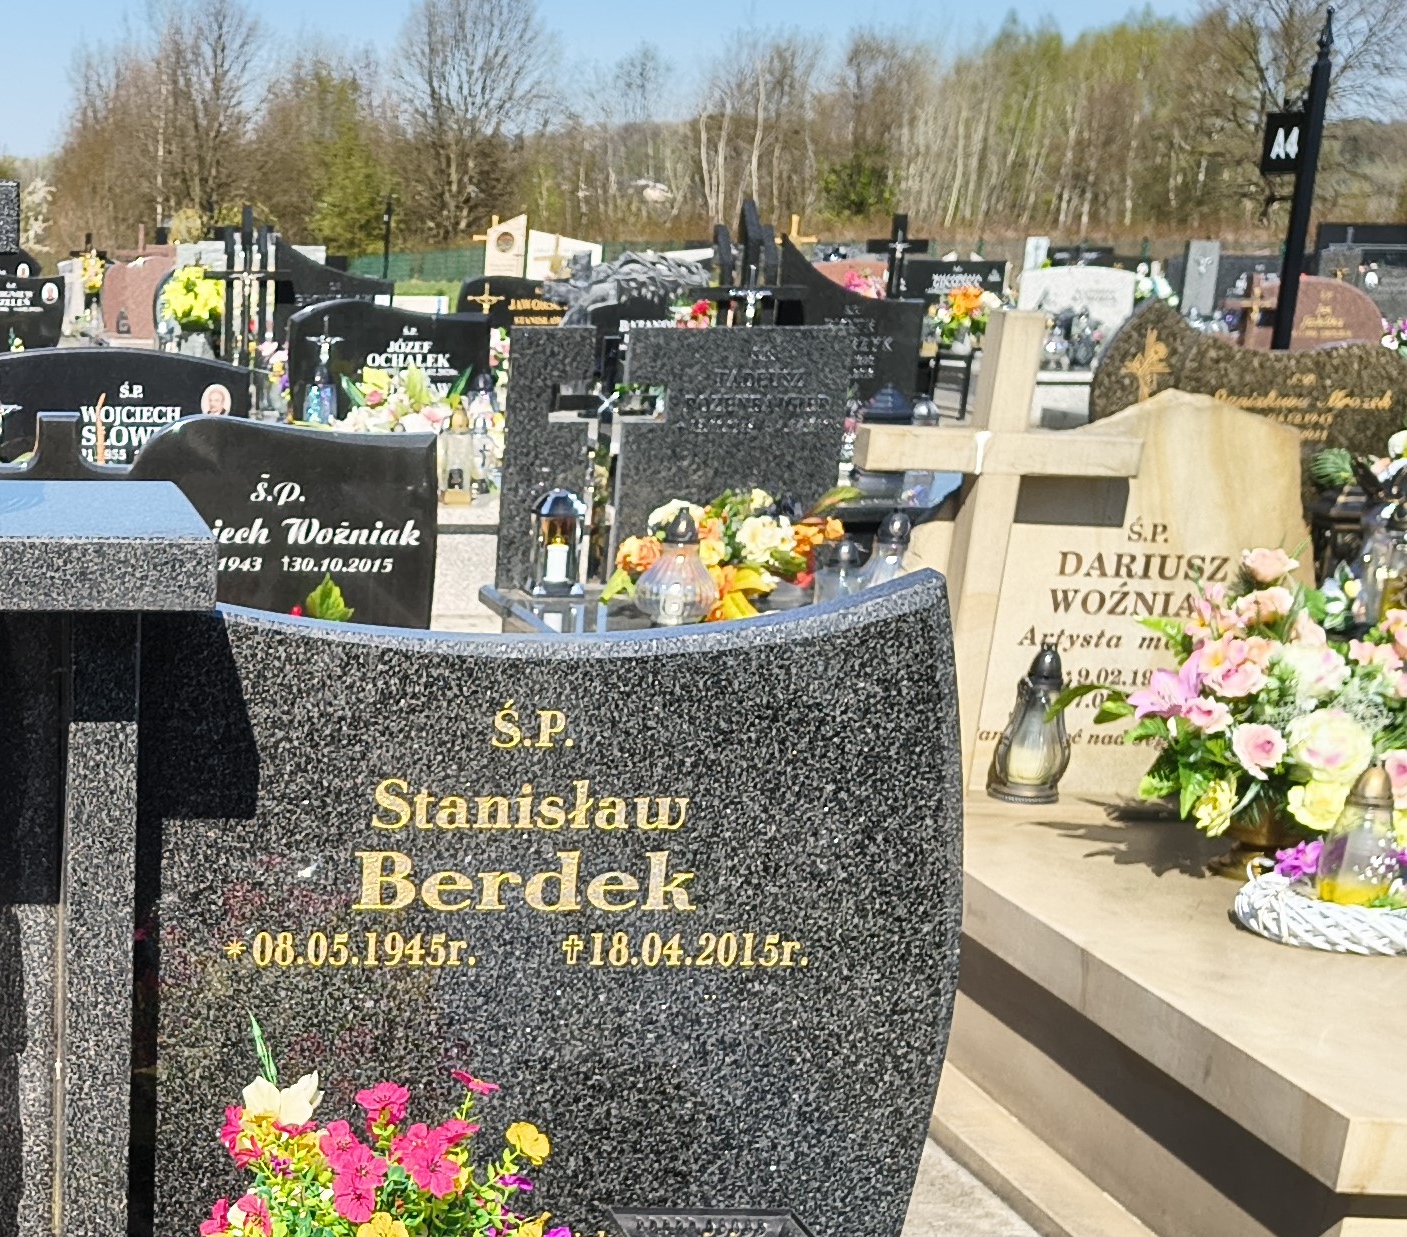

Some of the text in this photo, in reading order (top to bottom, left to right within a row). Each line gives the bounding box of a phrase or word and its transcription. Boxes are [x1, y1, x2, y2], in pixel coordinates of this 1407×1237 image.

[386, 337, 433, 353] JÓZEF
[80, 405, 182, 427] WOJCIECH
[280, 517, 421, 546] Woźniak
[1127, 518, 1169, 543] Ś.P.
[1058, 551, 1231, 582] DARIUSZ
[1050, 581, 1197, 618] WOŹNIA
[1018, 625, 1123, 652] Artysta
[491, 700, 575, 748] Ś.P.
[371, 778, 691, 831] Stanisław
[351, 850, 697, 912] Berdek
